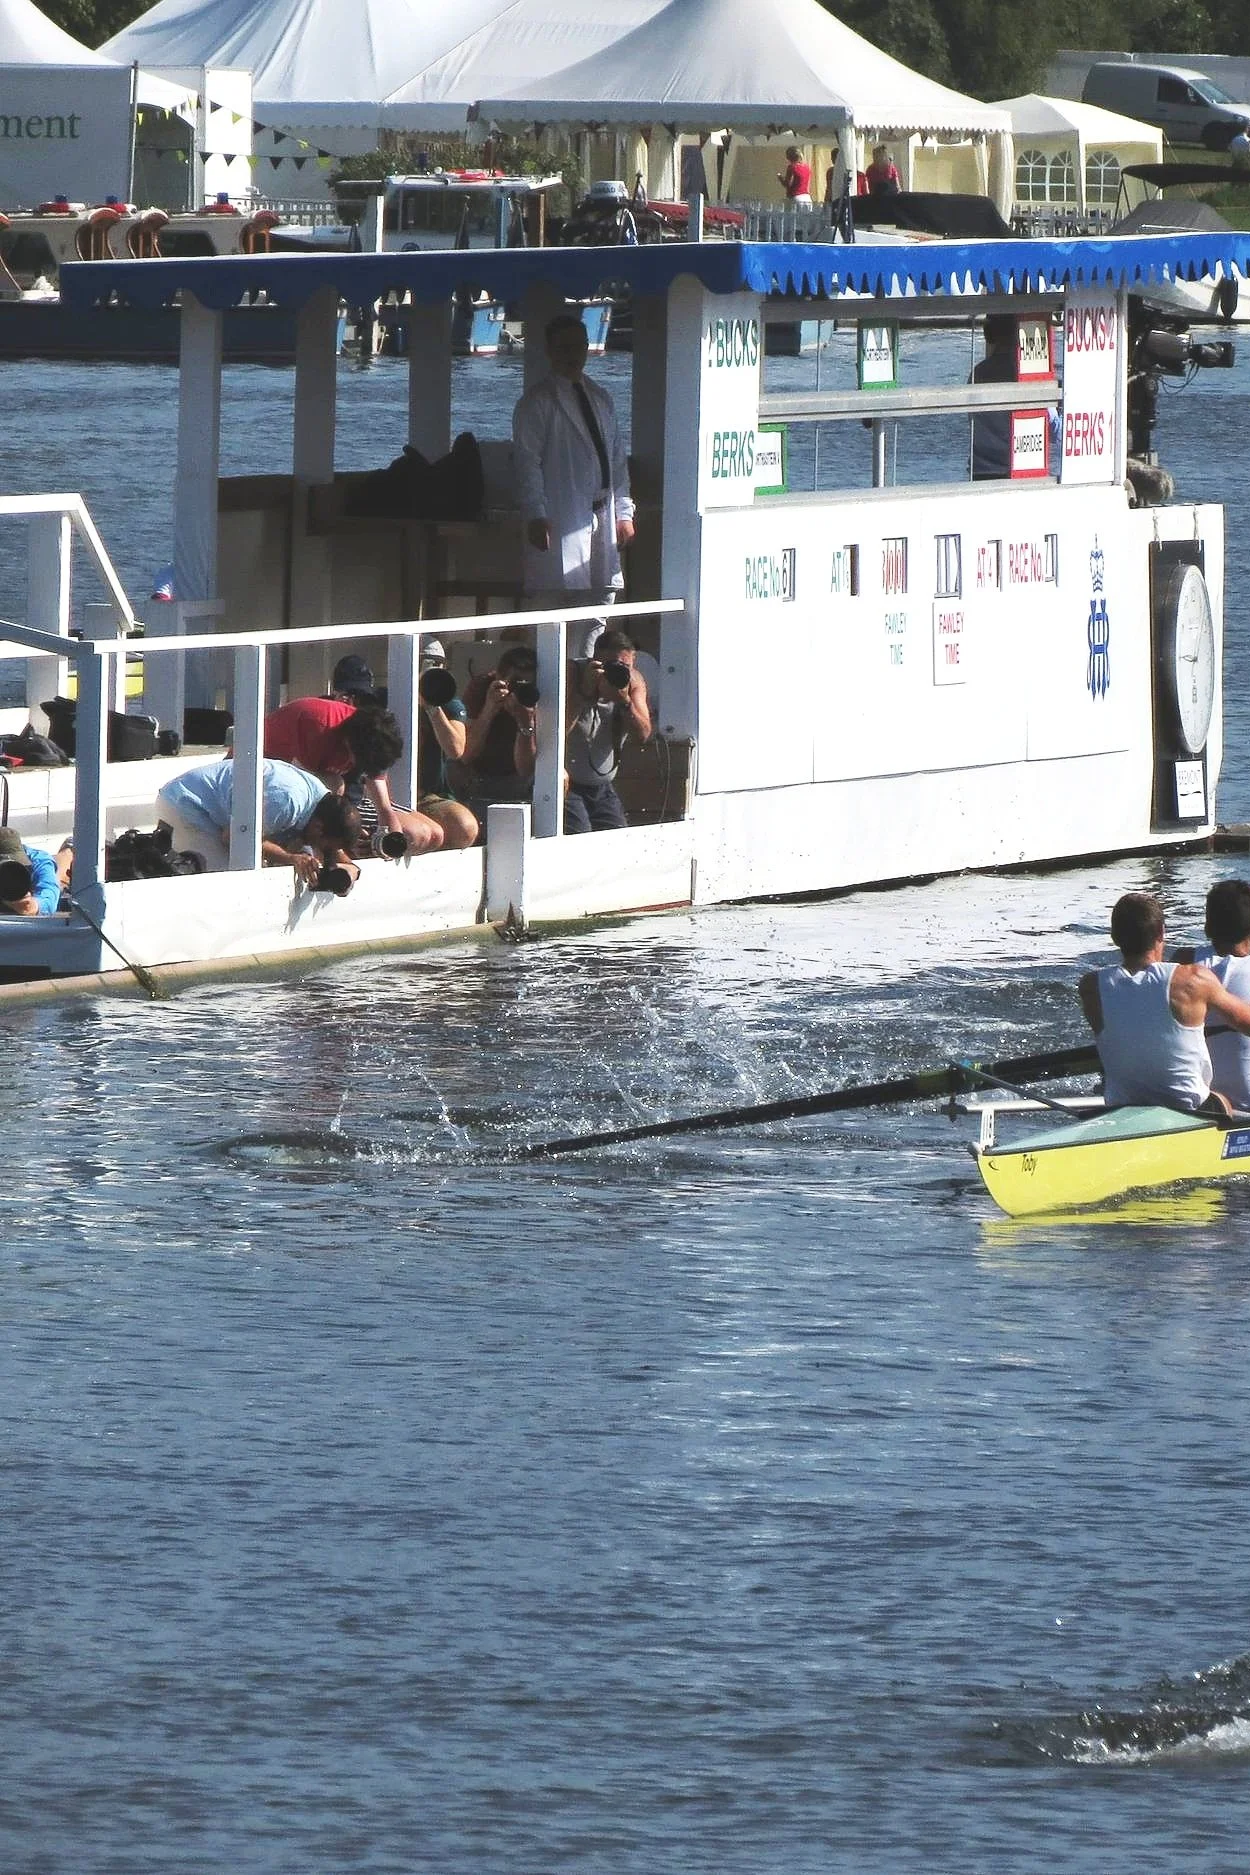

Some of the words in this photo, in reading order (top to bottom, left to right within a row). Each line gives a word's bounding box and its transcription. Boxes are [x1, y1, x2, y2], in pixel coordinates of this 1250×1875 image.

[716, 319, 759, 368] BUCKS
[1066, 307, 1106, 353] BUCKS
[711, 430, 756, 479] BERKS
[1065, 411, 1105, 456] BERKS
[745, 556, 769, 600] RACE
[1008, 543, 1029, 583] RACE
[938, 611, 965, 634] FAWLEY
[945, 643, 960, 665] TIME
[1020, 1153, 1038, 1177] Toby
